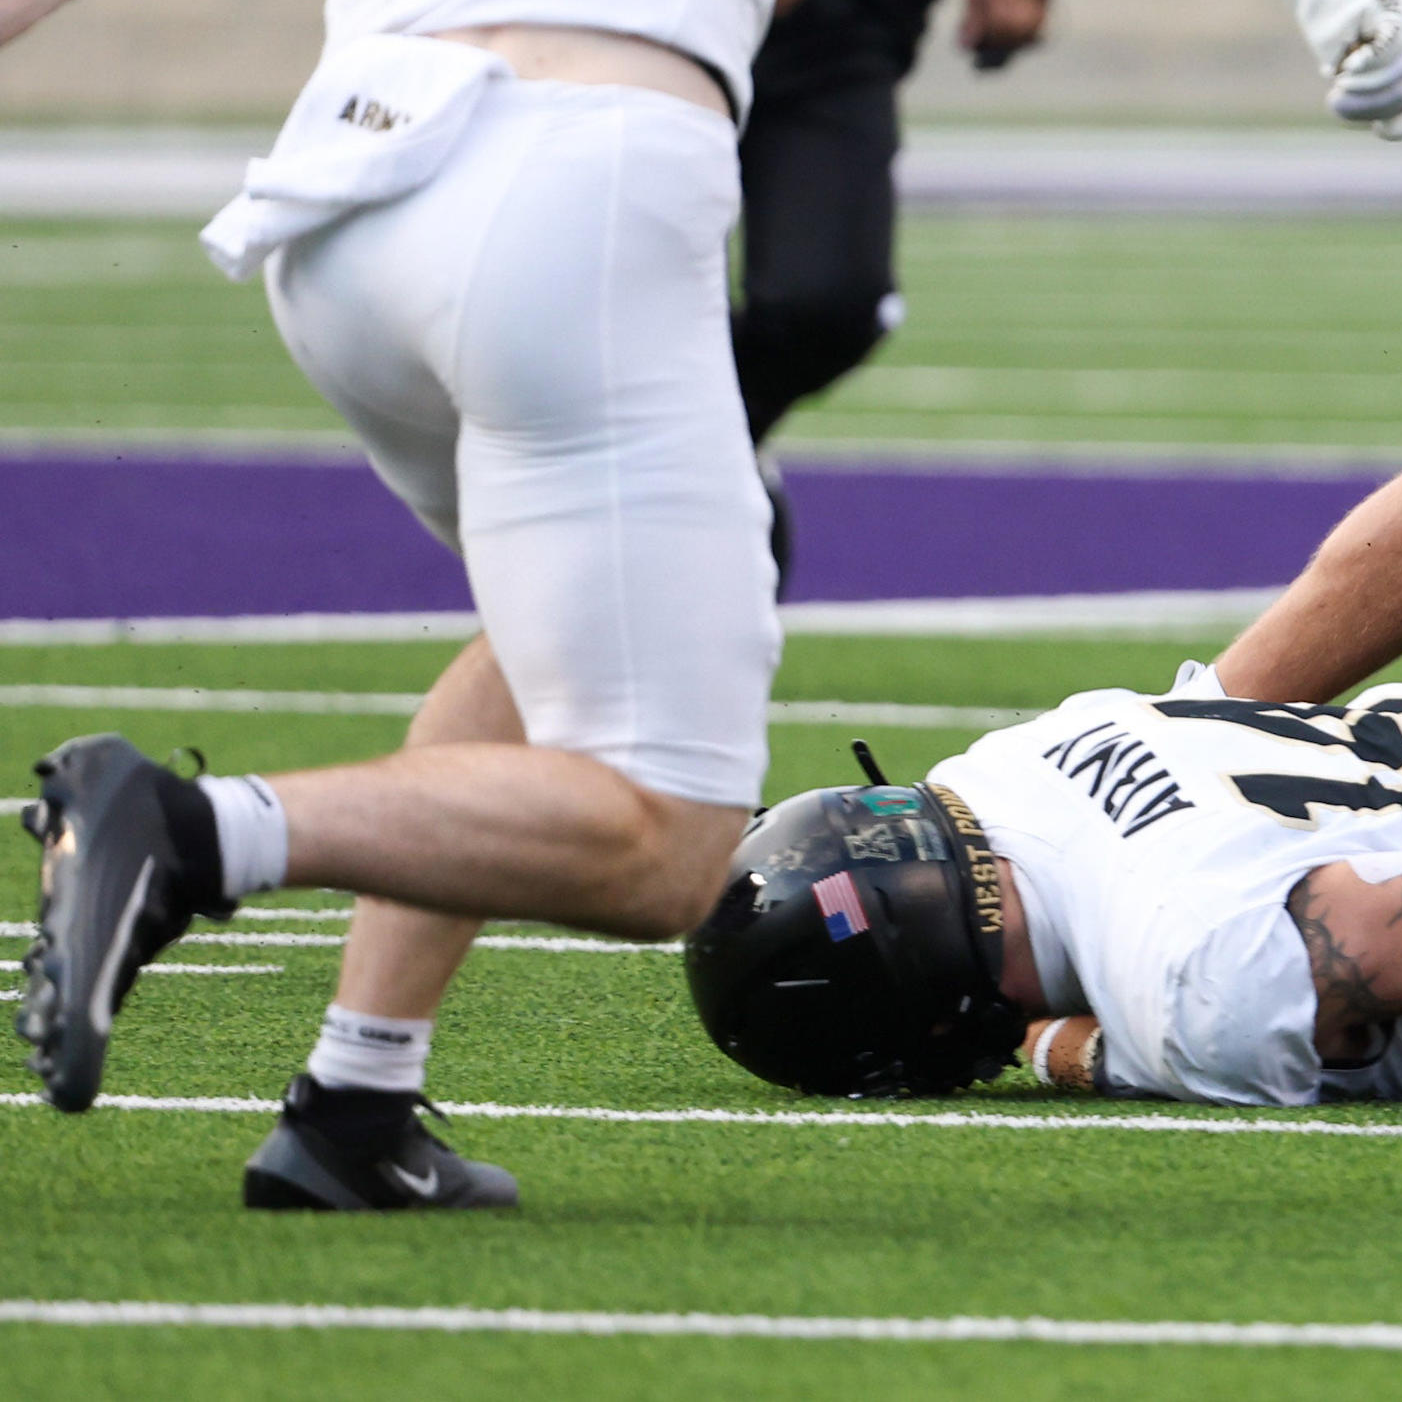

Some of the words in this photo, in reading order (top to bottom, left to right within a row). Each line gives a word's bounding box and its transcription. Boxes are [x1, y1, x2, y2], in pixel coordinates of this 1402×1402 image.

[338, 94, 413, 132] ARM
[927, 782, 985, 837] POIN
[1042, 721, 1198, 839] ARMY
[965, 843, 1004, 934] WEST
